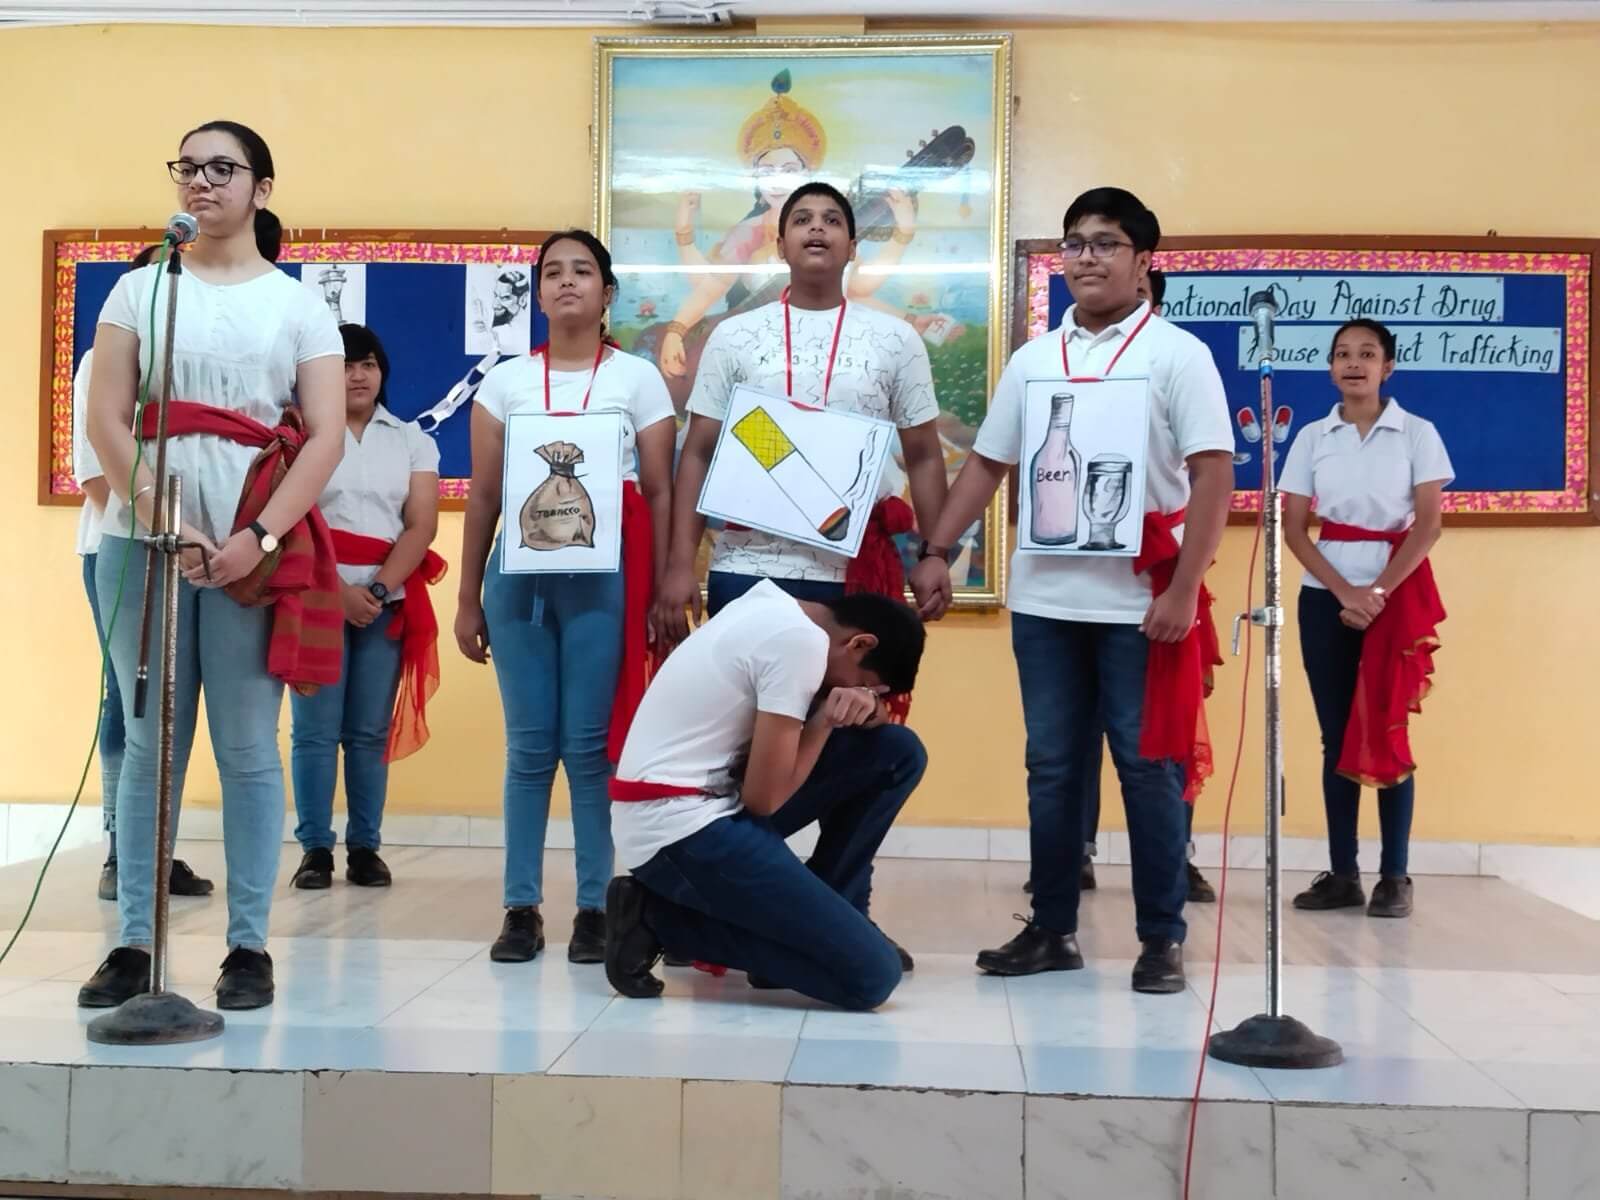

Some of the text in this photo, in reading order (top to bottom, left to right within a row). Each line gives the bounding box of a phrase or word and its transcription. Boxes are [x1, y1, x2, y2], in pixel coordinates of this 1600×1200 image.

[1329, 279, 1426, 320] Against
[1432, 284, 1497, 321] Drug
[1438, 331, 1554, 371] Trafficking
[1037, 468, 1071, 483] Beer
